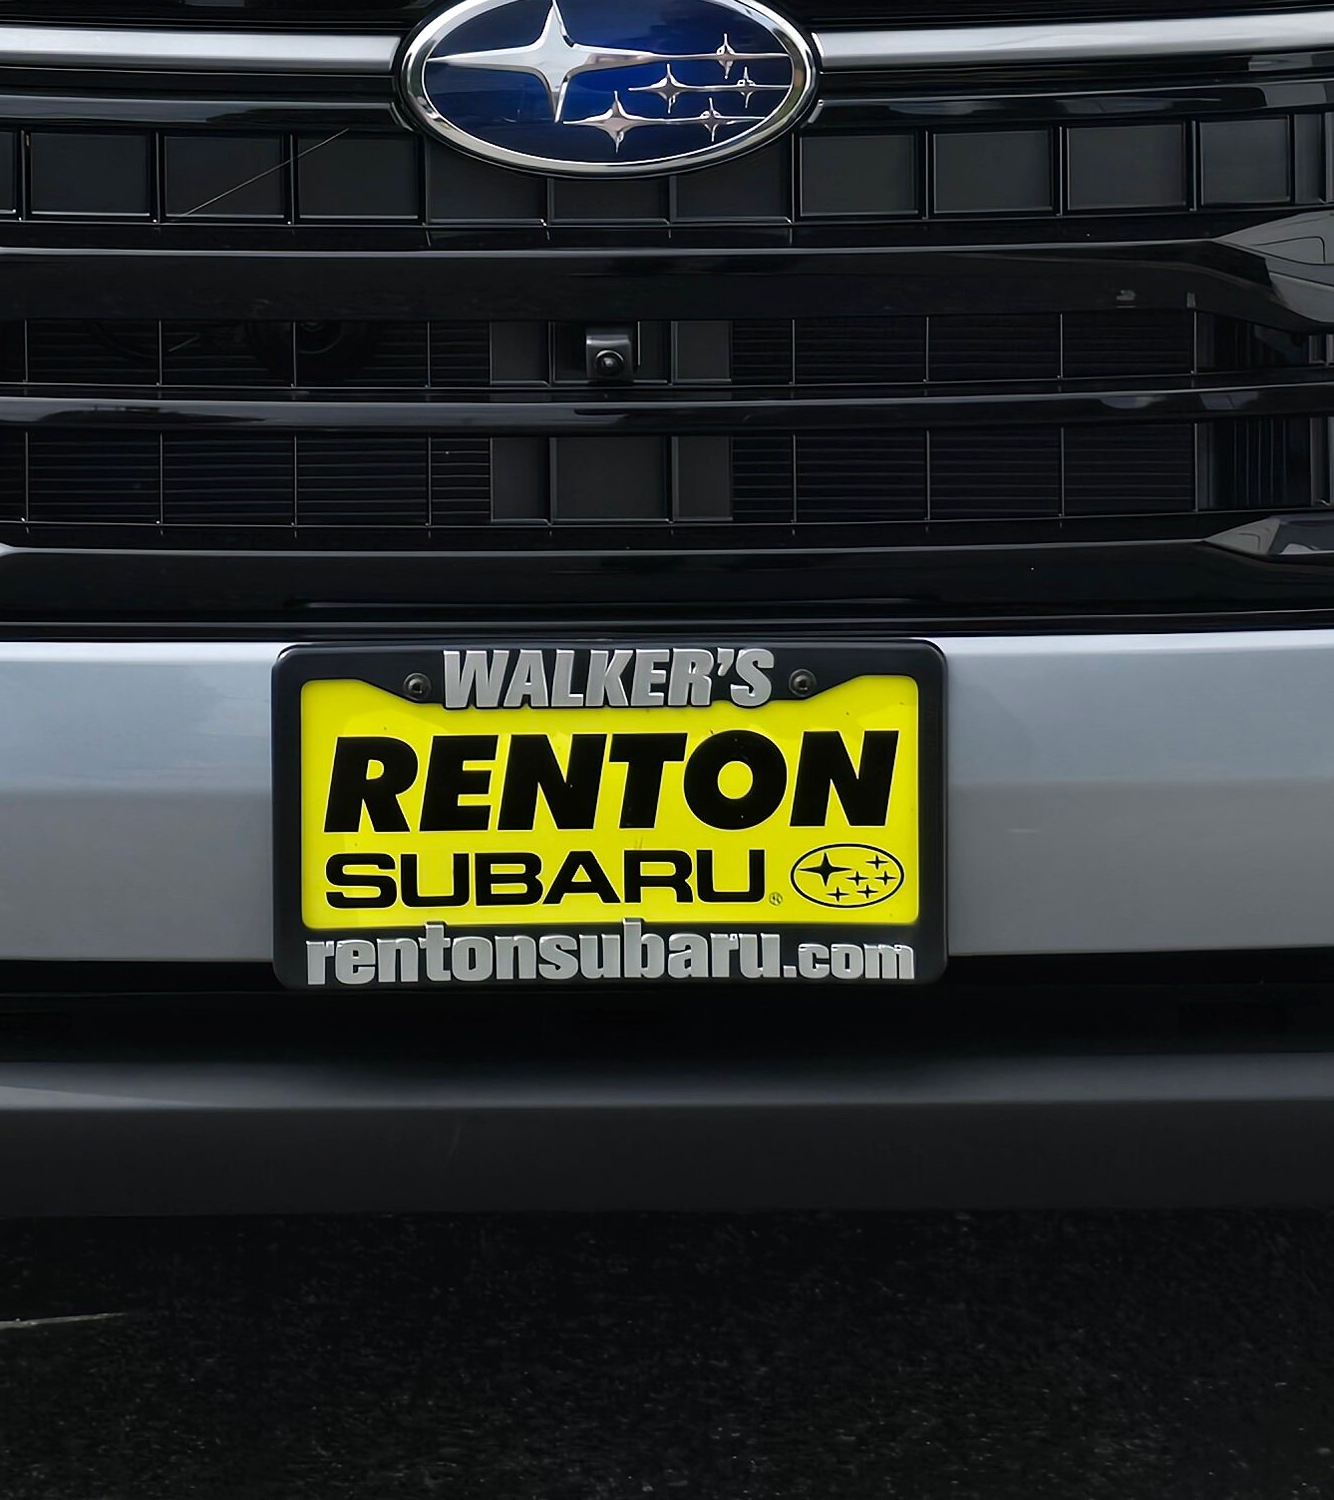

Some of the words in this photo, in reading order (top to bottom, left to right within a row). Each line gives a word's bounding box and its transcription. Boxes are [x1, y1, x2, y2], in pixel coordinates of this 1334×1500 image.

[444, 647, 774, 710] WALKER'S
[323, 729, 900, 833] RENTON
[325, 850, 766, 909] SUBARU
[305, 918, 916, 986] rentonsubaru.com
